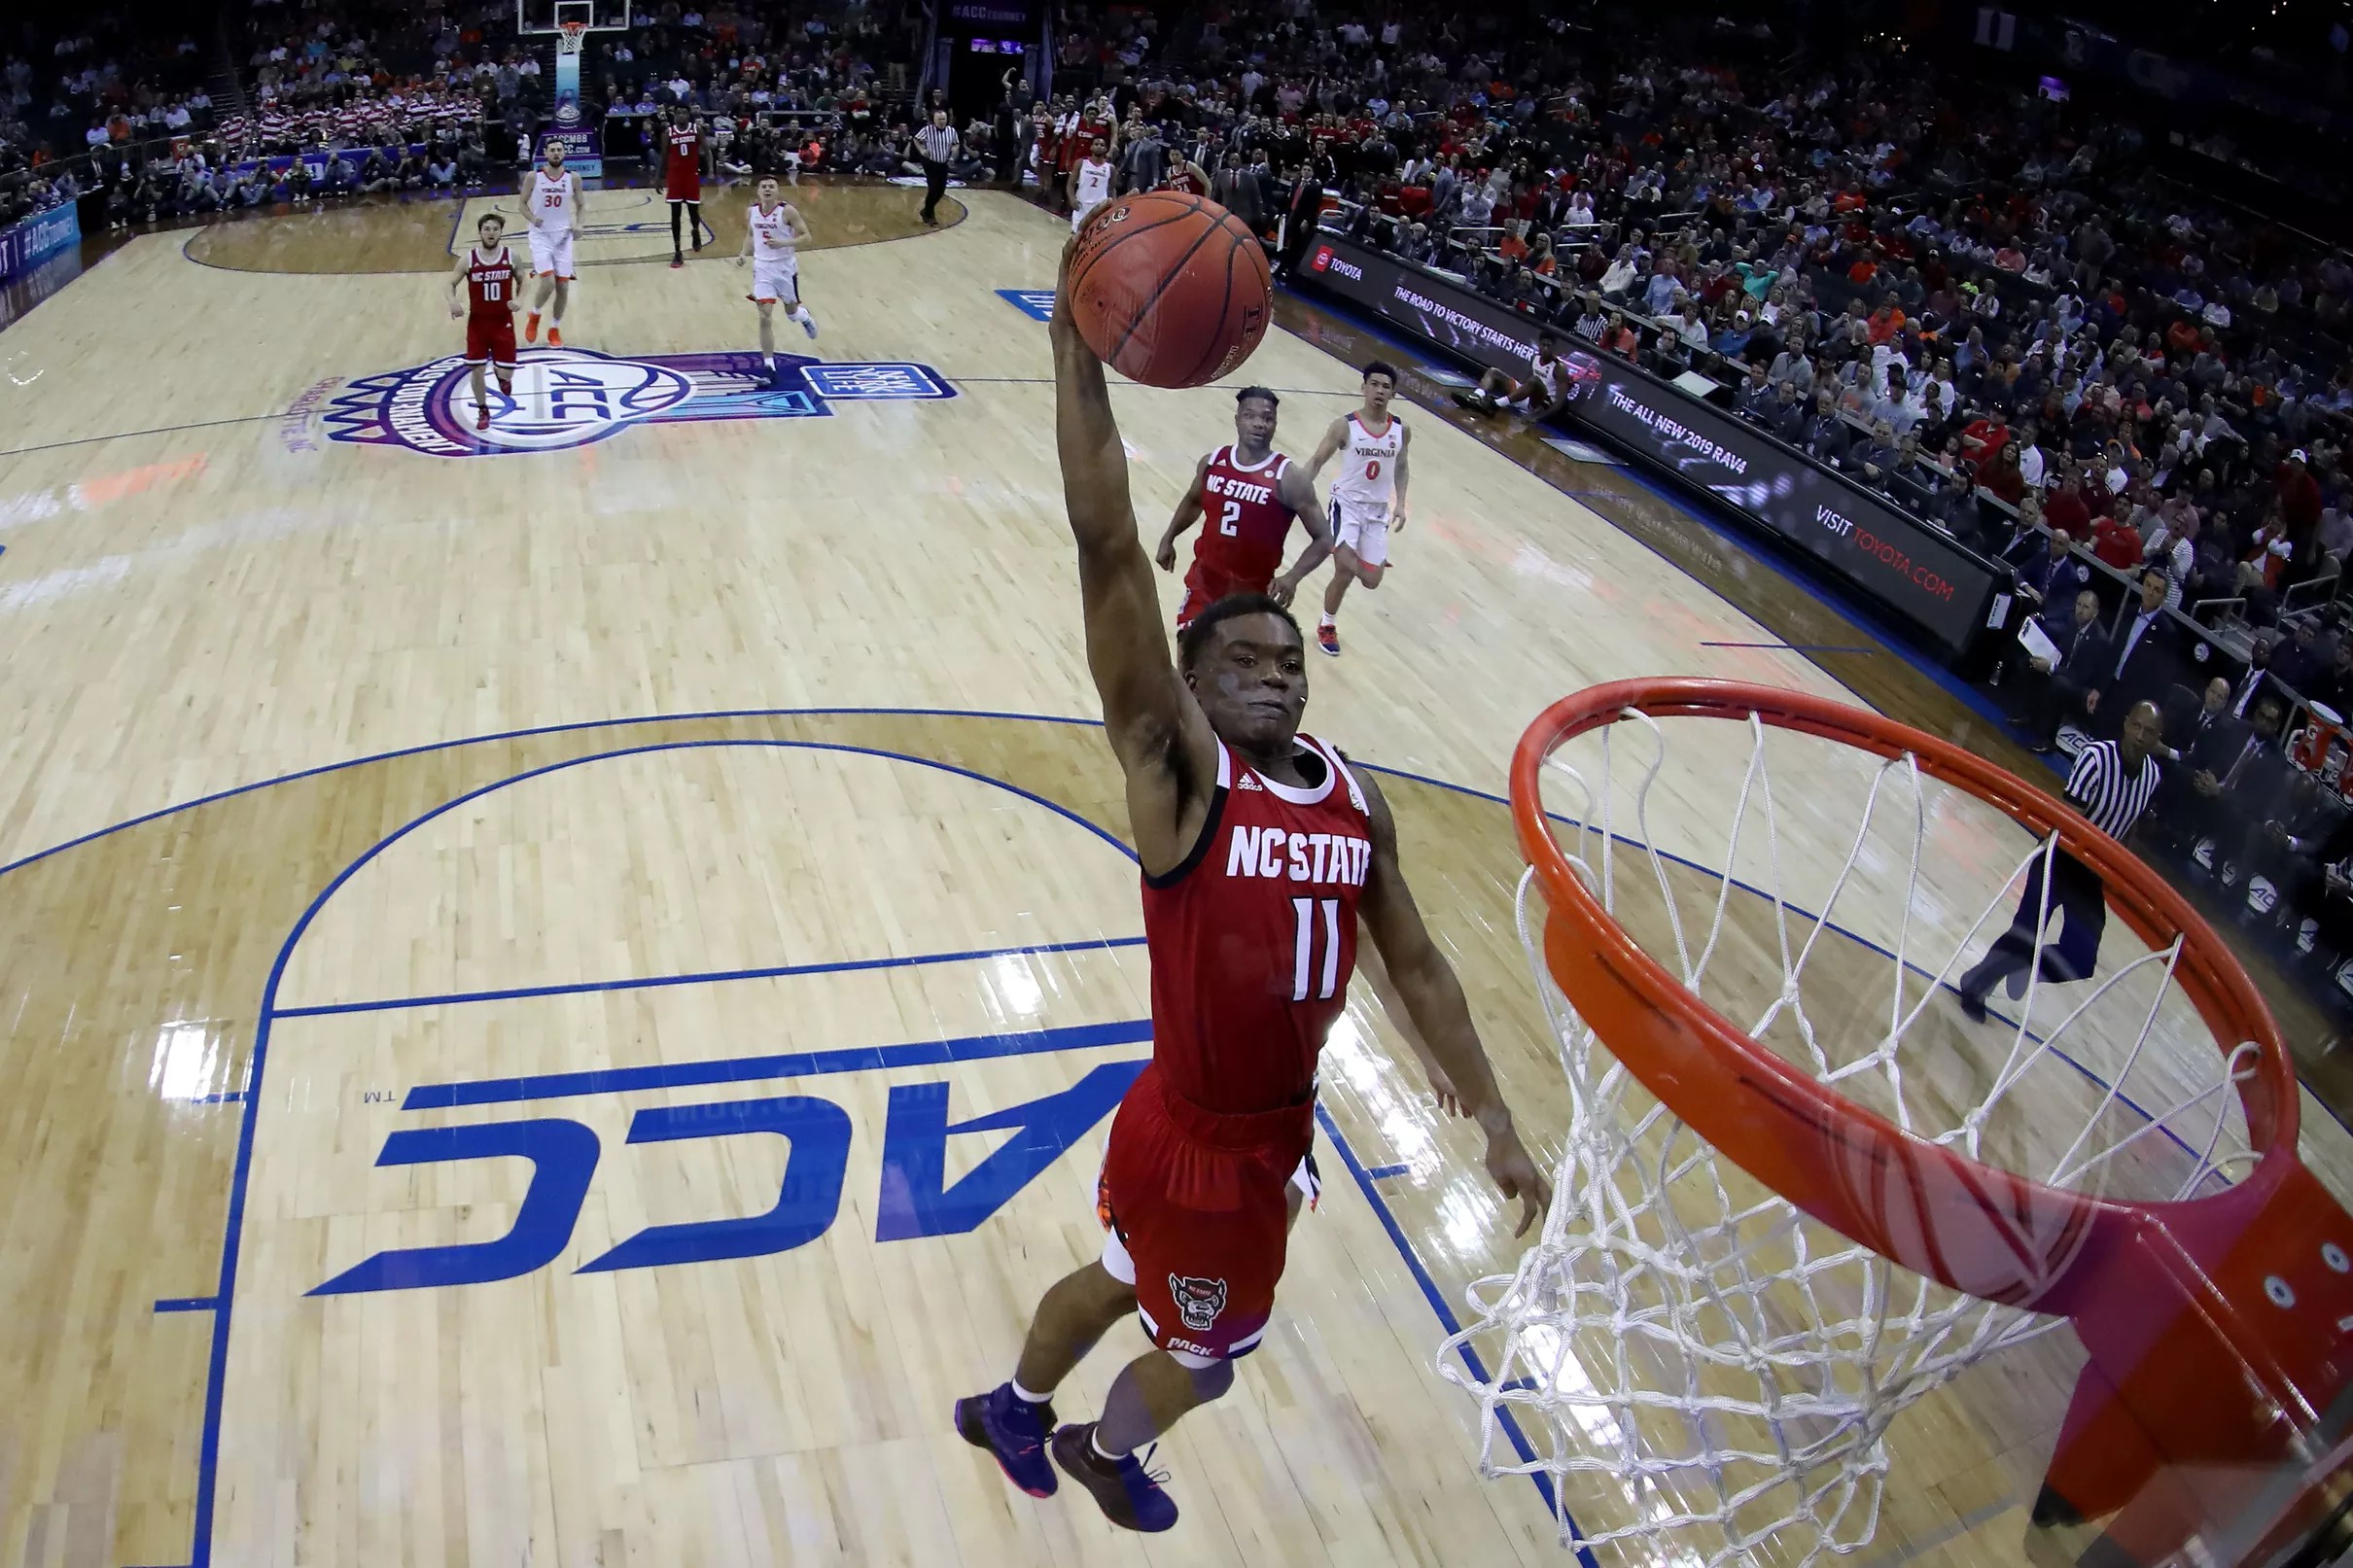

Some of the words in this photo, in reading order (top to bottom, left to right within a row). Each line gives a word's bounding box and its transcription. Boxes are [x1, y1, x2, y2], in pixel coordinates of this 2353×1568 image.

[681, 144, 687, 156] 0
[1090, 177, 1099, 187] 2
[544, 195, 562, 207] 30
[484, 269, 511, 281] STATE
[1329, 257, 1362, 282] TOYOTA
[483, 282, 501, 301] 10
[1393, 286, 1411, 303] THE
[1408, 292, 1434, 312] ROAD
[1432, 301, 1447, 318] TO
[1445, 308, 1482, 336] VICTORY
[1480, 326, 1515, 353] STARTS
[1513, 341, 1539, 363] HER
[825, 371, 857, 391] LIFE
[852, 367, 895, 393] YORK
[878, 370, 921, 391] NEW
[549, 368, 612, 421] ACC
[389, 378, 474, 453] TOURNAMENT
[1612, 391, 1634, 413] THE
[1633, 404, 1654, 425] ALL
[1653, 415, 1688, 440] NEW
[1683, 431, 1714, 455] 2019
[1711, 445, 1748, 475] RAV4
[1355, 447, 1395, 458] VIRGINIA
[1365, 460, 1382, 480] 0
[1207, 473, 1222, 494] NC
[1223, 478, 1273, 505] STATE
[1219, 500, 1241, 537] 2
[1814, 505, 1854, 537] VISIT
[1852, 527, 1955, 603] TOYOTA.COM
[1238, 783, 1263, 792] adidas
[1226, 825, 1286, 878] NC
[1292, 896, 1339, 1002] 11
[364, 1090, 397, 1104] TM
[302, 1056, 1154, 1298] ACC
[1167, 1337, 1214, 1356] PACK
